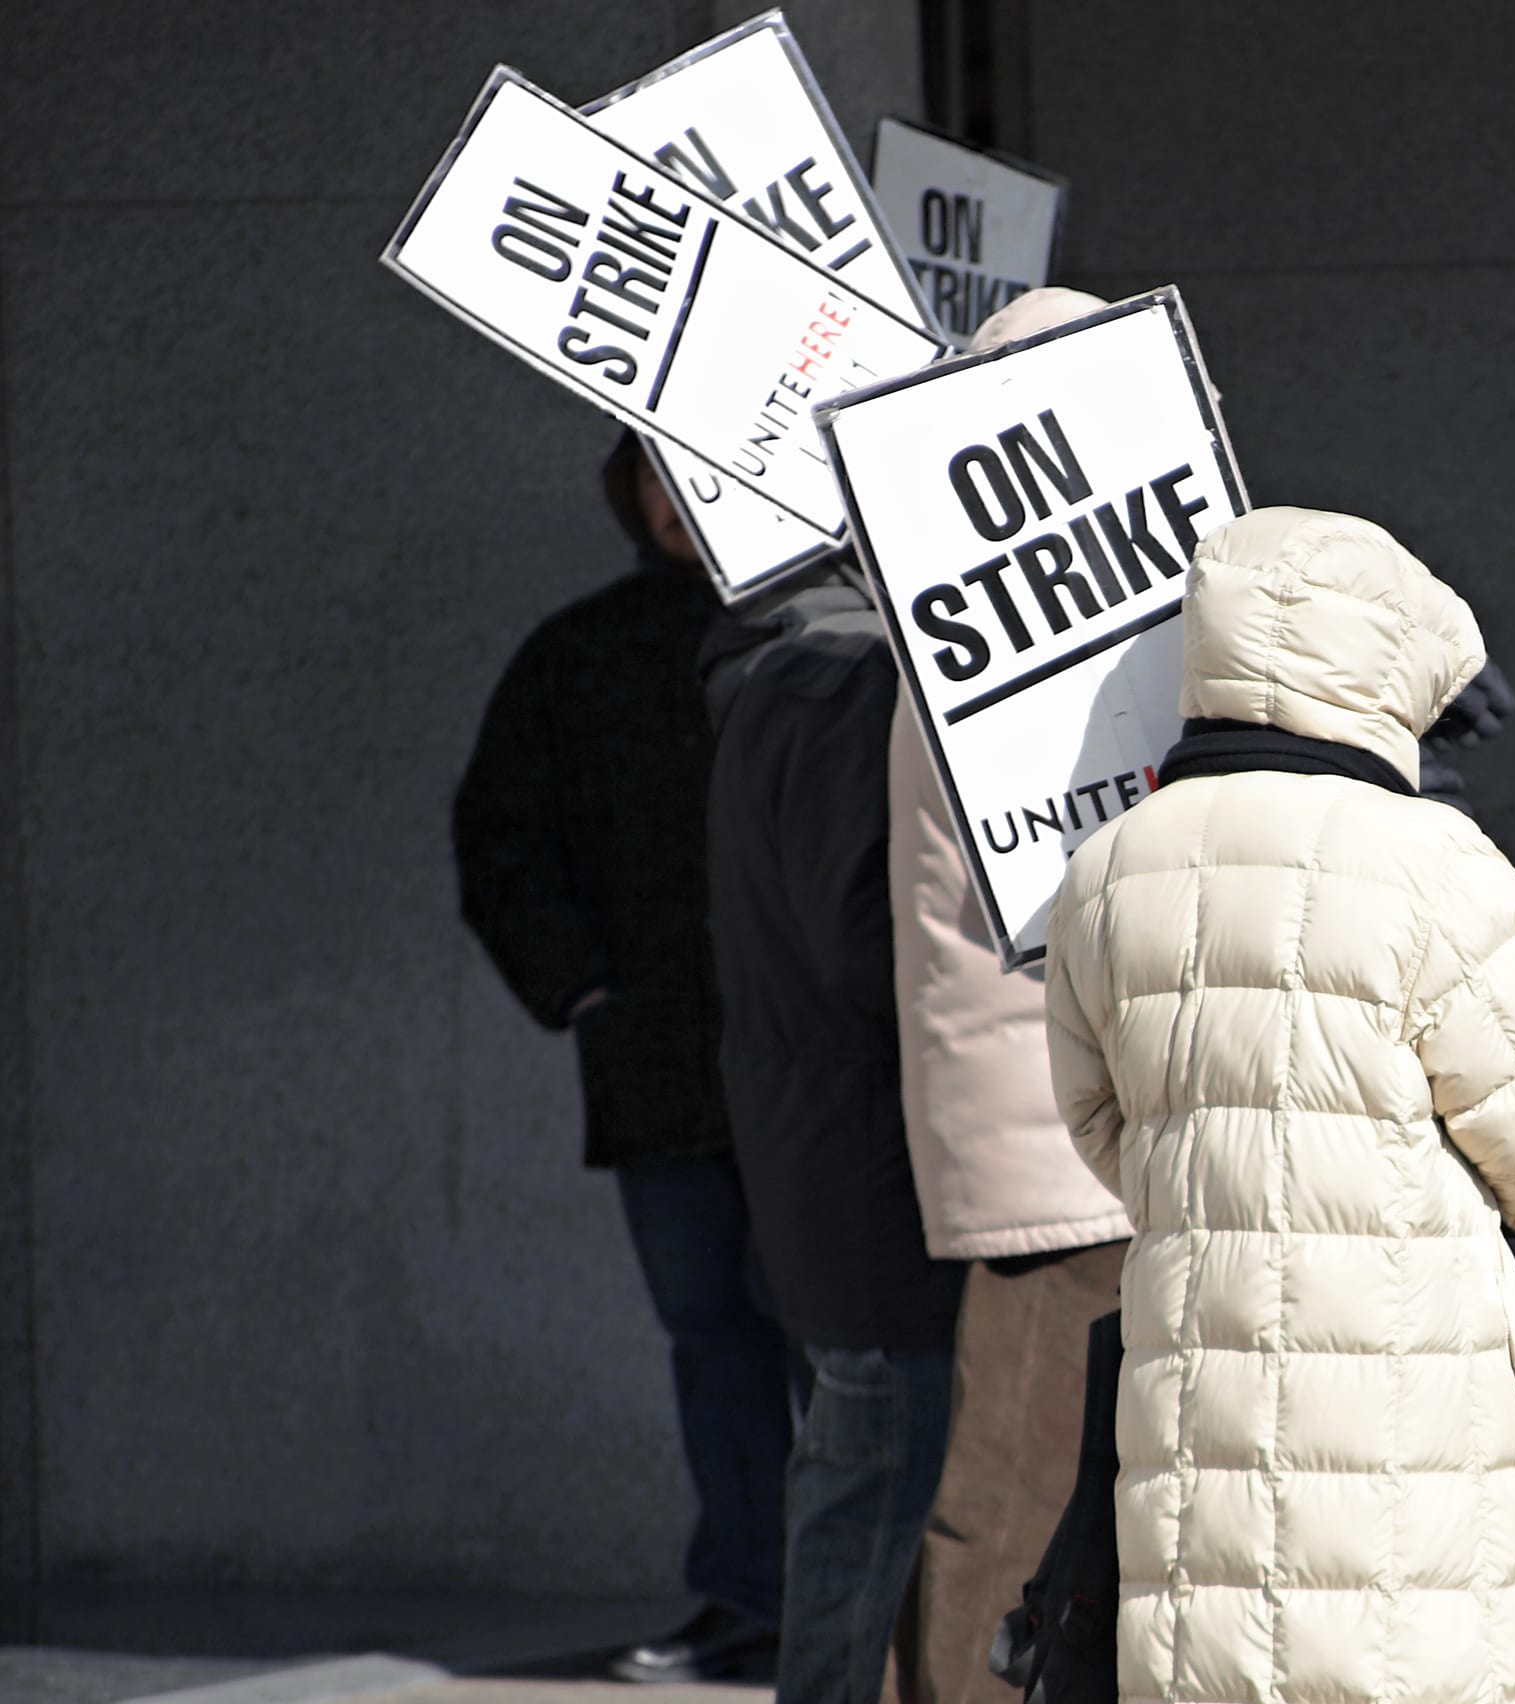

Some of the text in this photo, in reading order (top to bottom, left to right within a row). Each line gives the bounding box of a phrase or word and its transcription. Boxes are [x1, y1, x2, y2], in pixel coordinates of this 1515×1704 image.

[652, 126, 738, 201] N
[491, 176, 590, 282] ON
[557, 169, 691, 386] STRIKE
[921, 186, 984, 264] ON
[948, 408, 1094, 542] ON
[911, 463, 1209, 682] STRIKE
